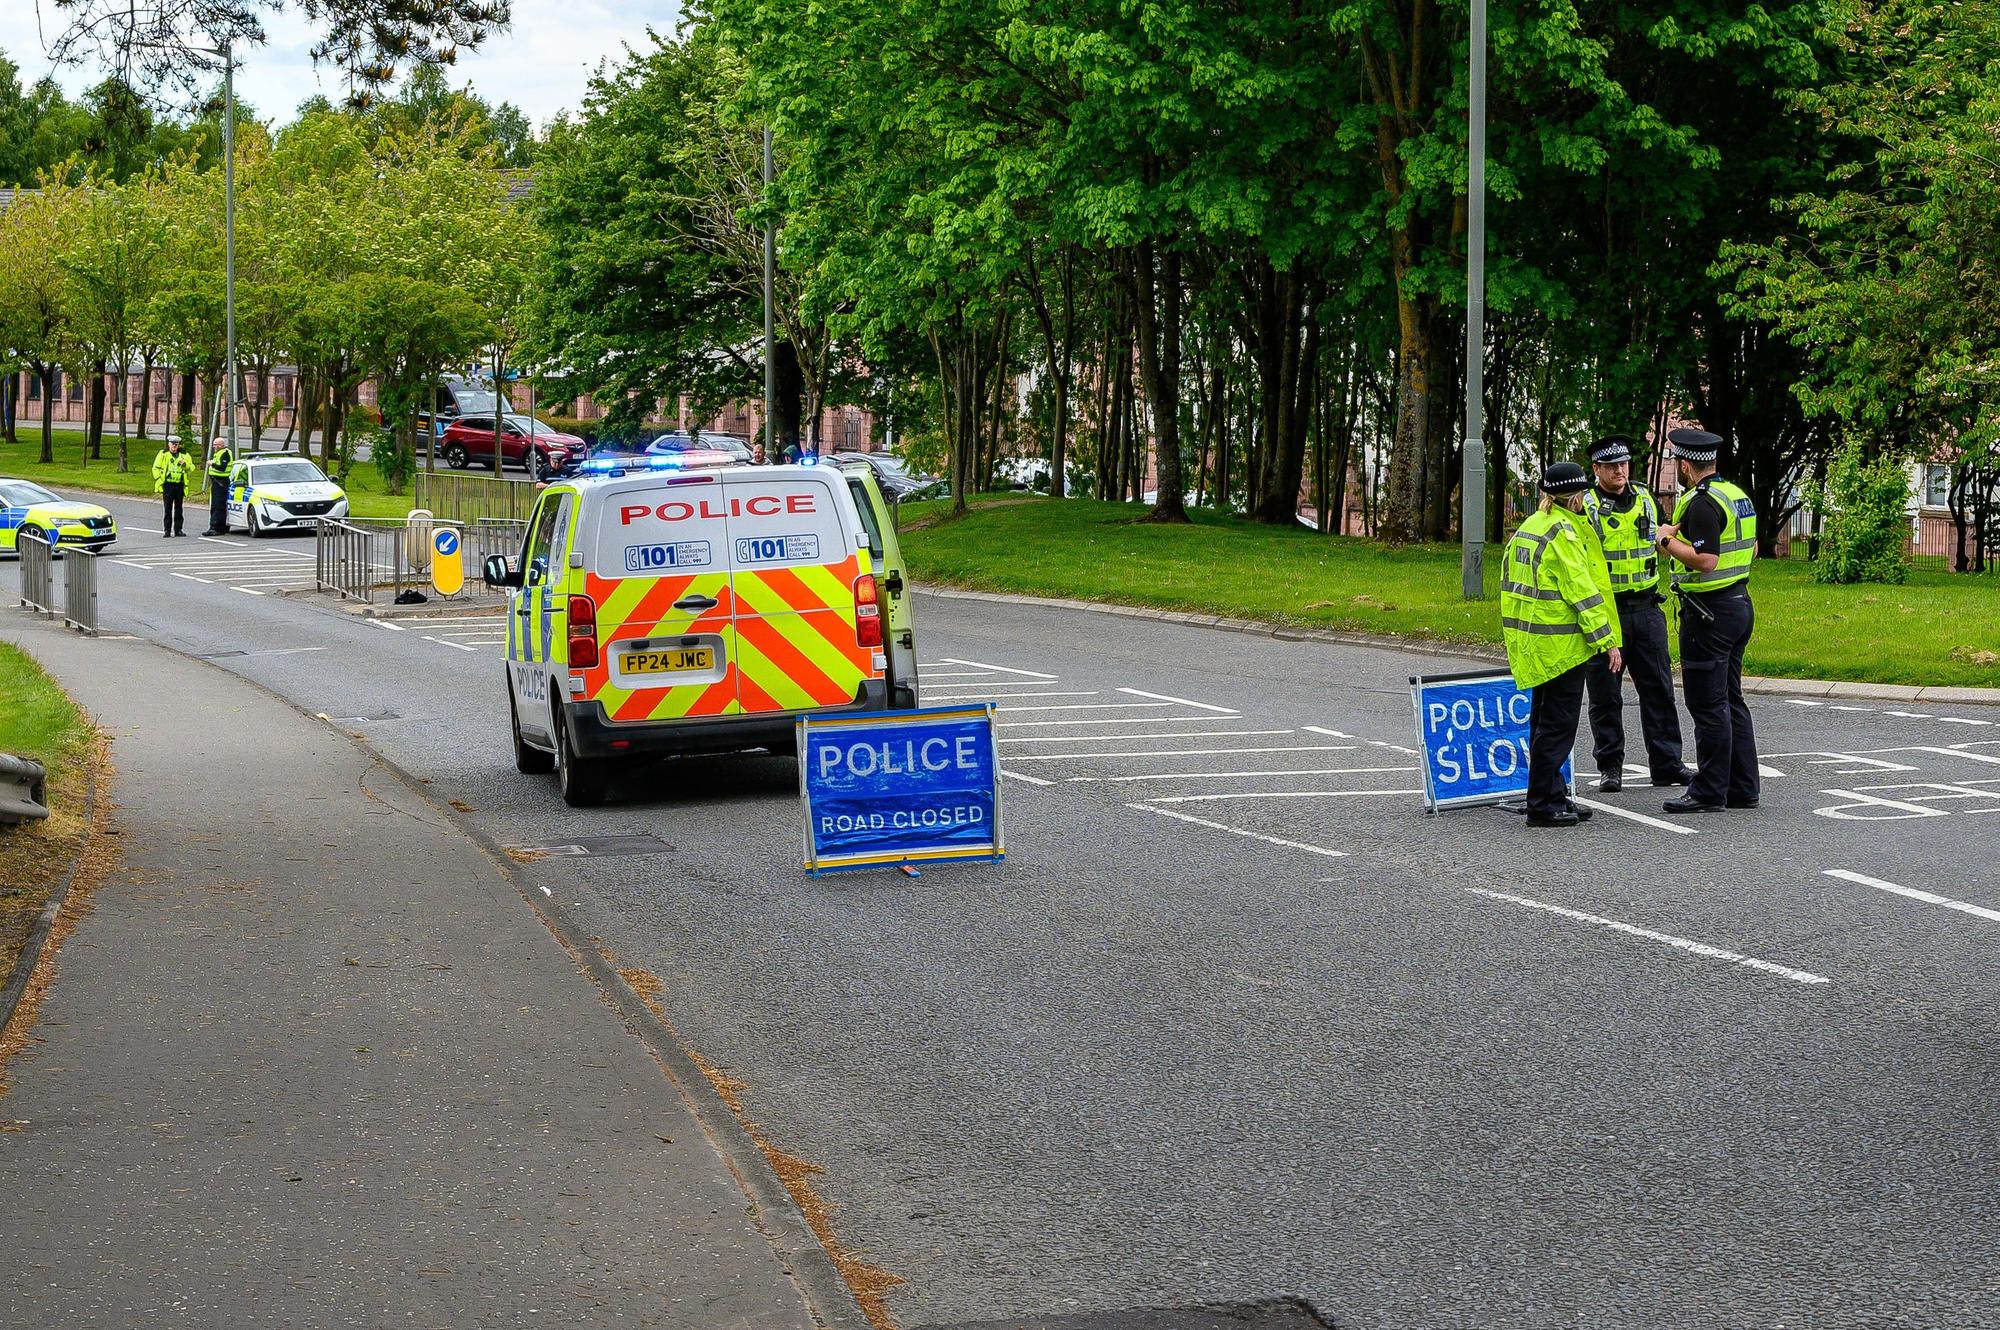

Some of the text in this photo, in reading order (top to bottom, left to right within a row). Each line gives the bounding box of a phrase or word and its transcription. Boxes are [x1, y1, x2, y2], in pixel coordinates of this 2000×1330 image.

[620, 495, 817, 526] POLICE
[640, 546, 676, 567] 101
[679, 547, 708, 555] EMERGENCY
[751, 538, 785, 559] 101
[626, 652, 706, 671] FP24 JWC
[517, 667, 545, 701] POLICE
[1428, 693, 1531, 734] POLIC
[819, 736, 979, 778] POLICE
[821, 805, 984, 834] ROAD CLOSED
